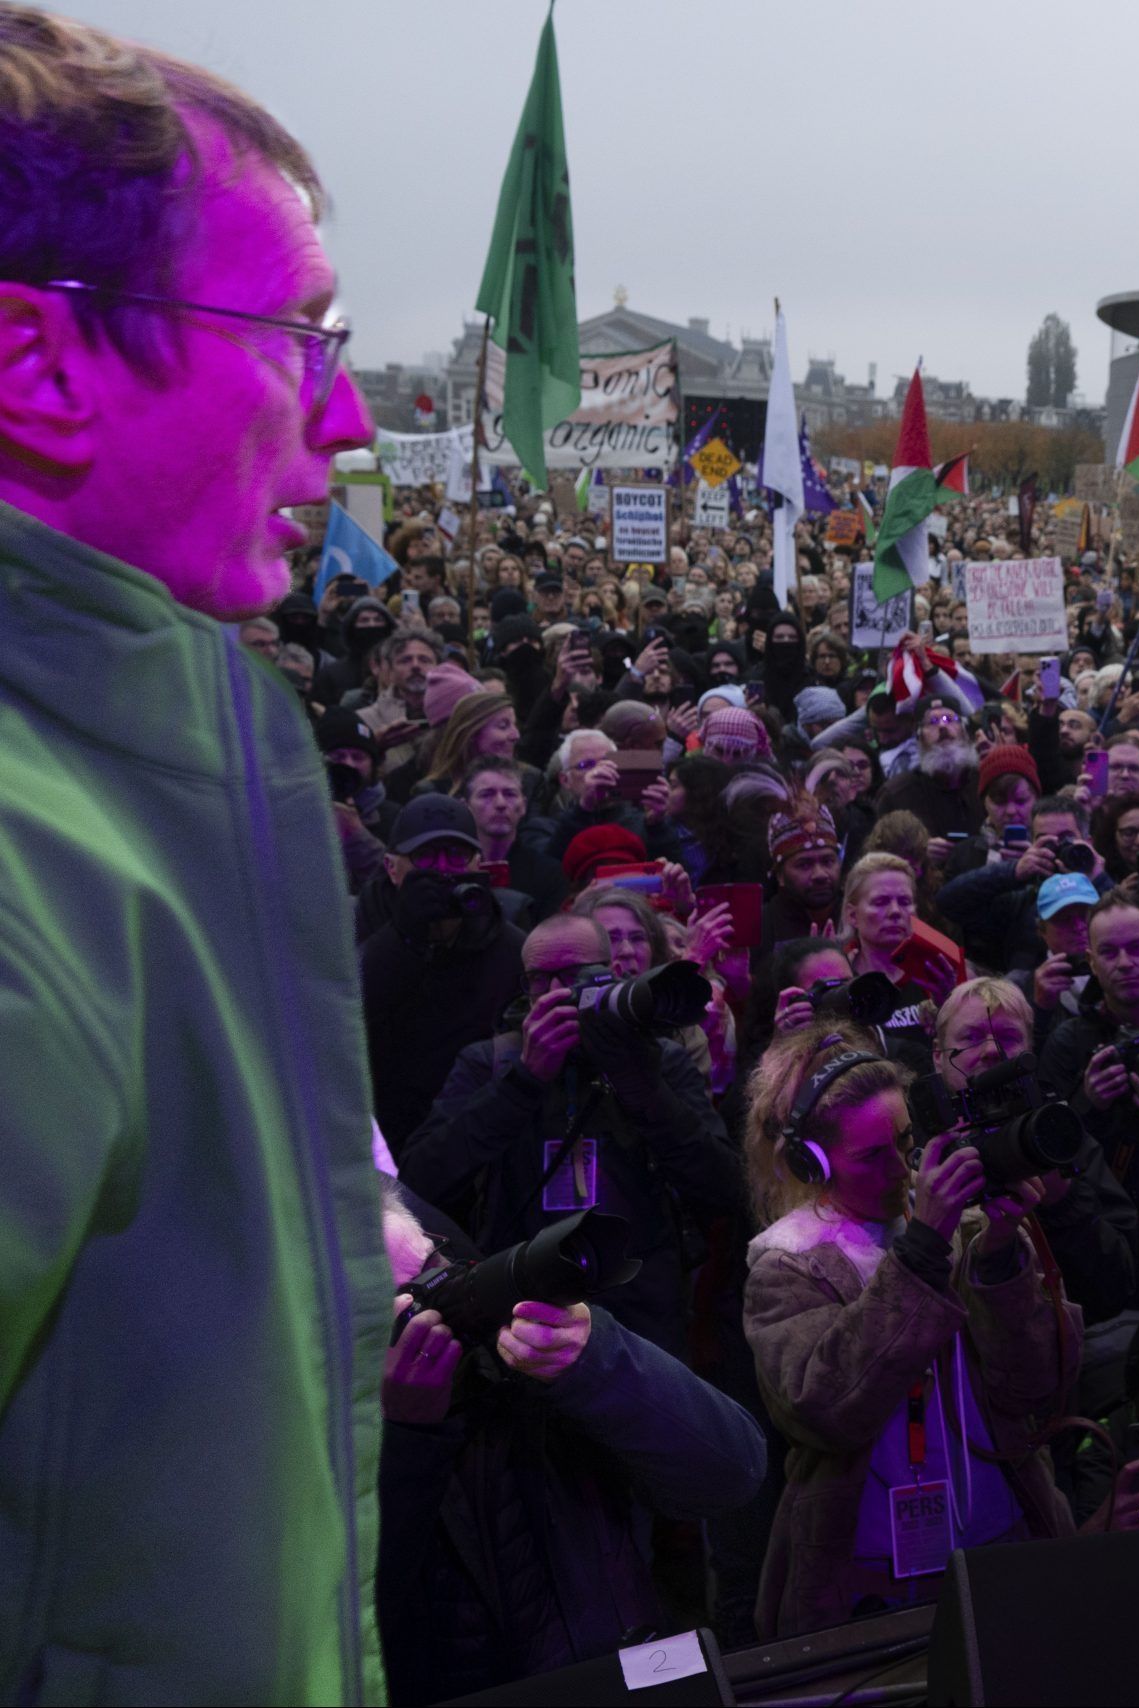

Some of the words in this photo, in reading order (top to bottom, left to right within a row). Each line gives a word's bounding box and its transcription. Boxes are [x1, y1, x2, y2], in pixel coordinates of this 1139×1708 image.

[699, 451, 733, 466] DEAD
[702, 465, 728, 478] END
[615, 493, 662, 507] BOYCOT
[701, 491, 725, 501] KEEP
[896, 1495, 945, 1520] PERS
[648, 1649, 680, 1672] 2
